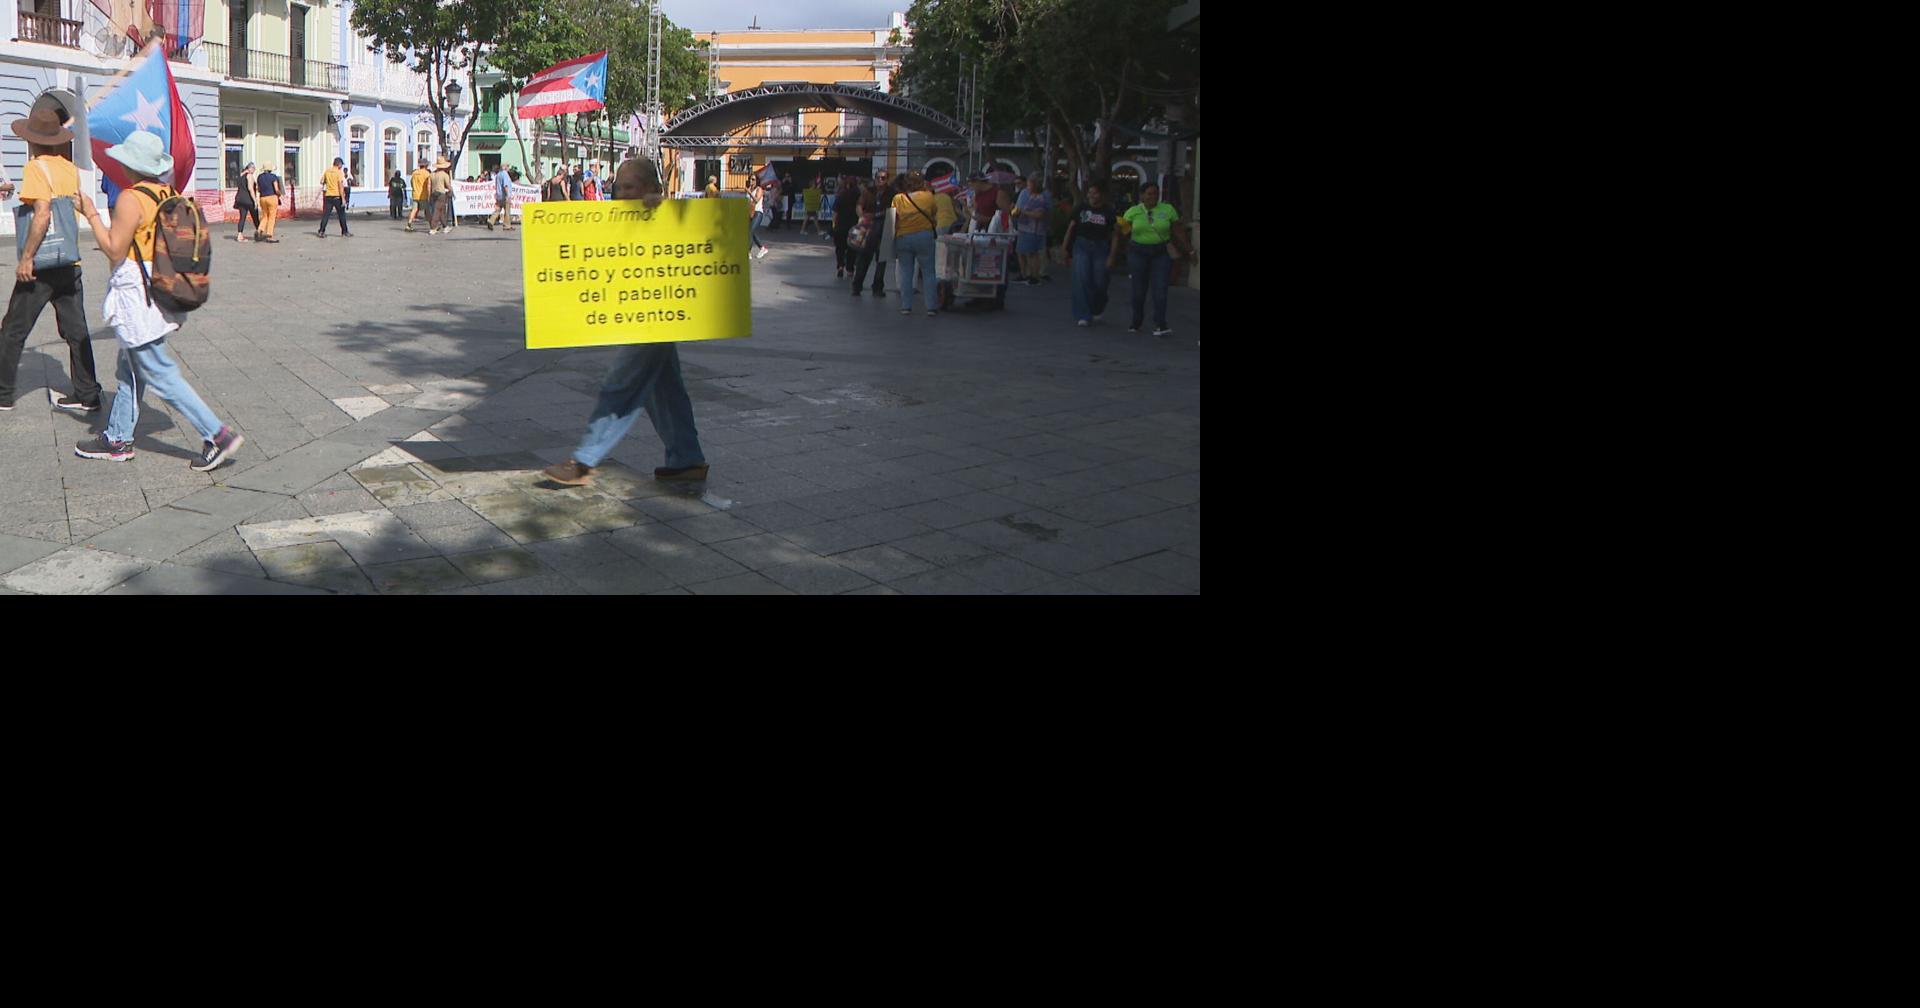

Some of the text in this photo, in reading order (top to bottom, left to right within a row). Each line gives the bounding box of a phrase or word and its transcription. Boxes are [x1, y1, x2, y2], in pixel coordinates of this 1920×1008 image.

[531, 208, 603, 225] Romero
[559, 239, 714, 261] El pueblo pagará
[536, 260, 741, 283] diseño y construcción
[578, 284, 697, 303] del pabellón
[586, 309, 692, 325] de eventos.
